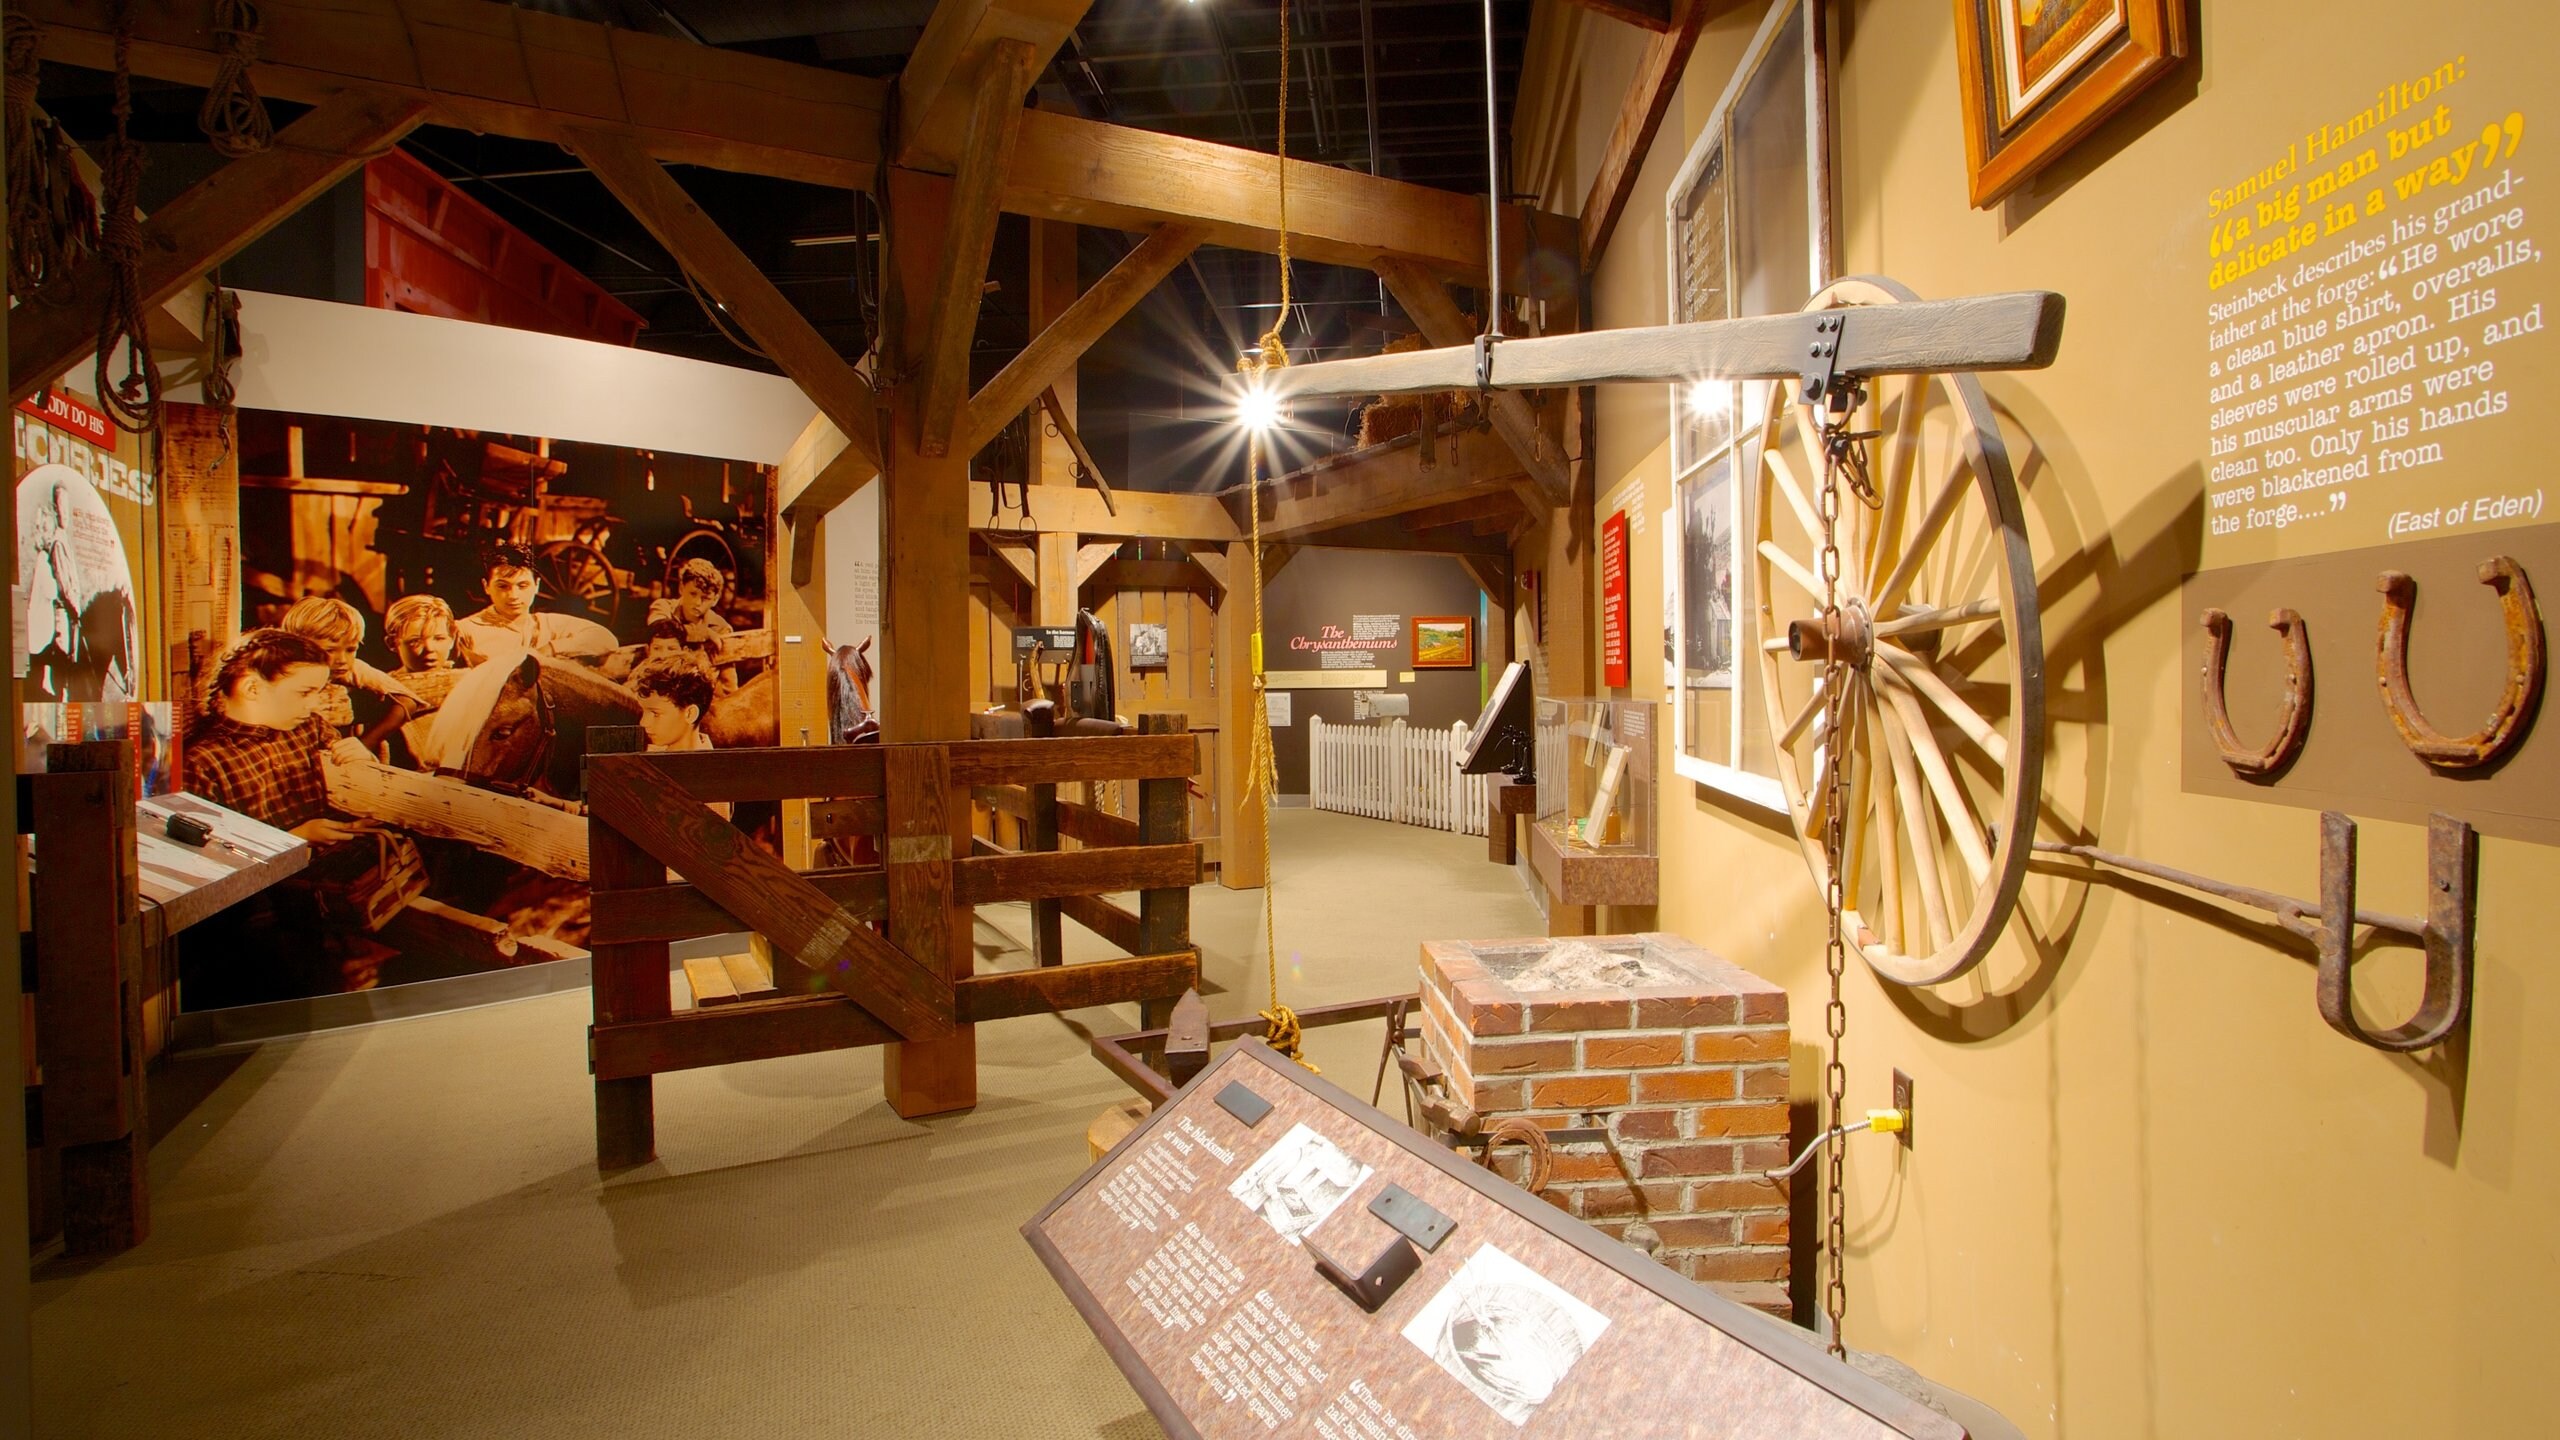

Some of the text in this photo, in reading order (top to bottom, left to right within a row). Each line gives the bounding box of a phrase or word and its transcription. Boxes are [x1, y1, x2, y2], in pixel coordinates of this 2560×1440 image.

[2209, 55, 2466, 219] Samuel Hamilton:
[2209, 112, 2524, 290] delicate in a way”
[2210, 104, 2451, 258] “a big man but
[2208, 169, 2525, 325] Steinbeck describes his grand-
[2209, 207, 2524, 351] father at the forge: “He wore
[2209, 238, 2542, 377] a clean blue shirt, overalls,
[2210, 287, 2497, 404] and a leather apron. His
[2211, 304, 2544, 430] sleeves were rolled up, and
[71, 405, 86, 427] DO
[89, 415, 104, 436] HIS
[2211, 360, 2494, 456] his muscular arms were
[2211, 390, 2508, 483] clean too. Only his hands
[2212, 442, 2444, 509] were blackened from
[2211, 491, 2346, 535] the forge....”
[2388, 489, 2543, 538] (East of Eden)
[1290, 635, 1398, 653] Chrysanthemums
[1321, 625, 1345, 639] The
[1163, 1131, 1193, 1156] at work
[1178, 1117, 1234, 1165] The blacksmith
[1111, 1200, 1122, 1213] for
[1151, 1192, 1166, 1205] some
[1156, 1249, 1178, 1273] bellows
[1194, 1291, 1204, 1302] on
[1202, 1299, 1211, 1309] it
[1165, 1241, 1227, 1306] the forge and pulled a
[1175, 1231, 1240, 1295] in the black square of
[1185, 1222, 1200, 1239] “He
[1199, 1235, 1215, 1253] built
[1217, 1256, 1233, 1271] chip
[1230, 1268, 1245, 1282] fire
[1126, 1277, 1175, 1329] until it glowed.”
[1136, 1269, 1192, 1332] over with his fingers
[1146, 1259, 1206, 1325] and then fed wet coke
[1255, 1290, 1321, 1354] “He took the red
[1223, 1321, 1297, 1400] in them and bent the
[1232, 1312, 1307, 1386] punched screw holes
[1244, 1302, 1328, 1384] straps to his anvil and
[1190, 1352, 1237, 1403] leaped out.”
[1201, 1343, 1277, 1429] and the forked sparks
[1212, 1333, 1293, 1419] angle with his hammer
[1350, 1379, 1382, 1414] “Then
[1382, 1410, 1397, 1428] he
[1337, 1392, 1393, 1440] iron hissin
